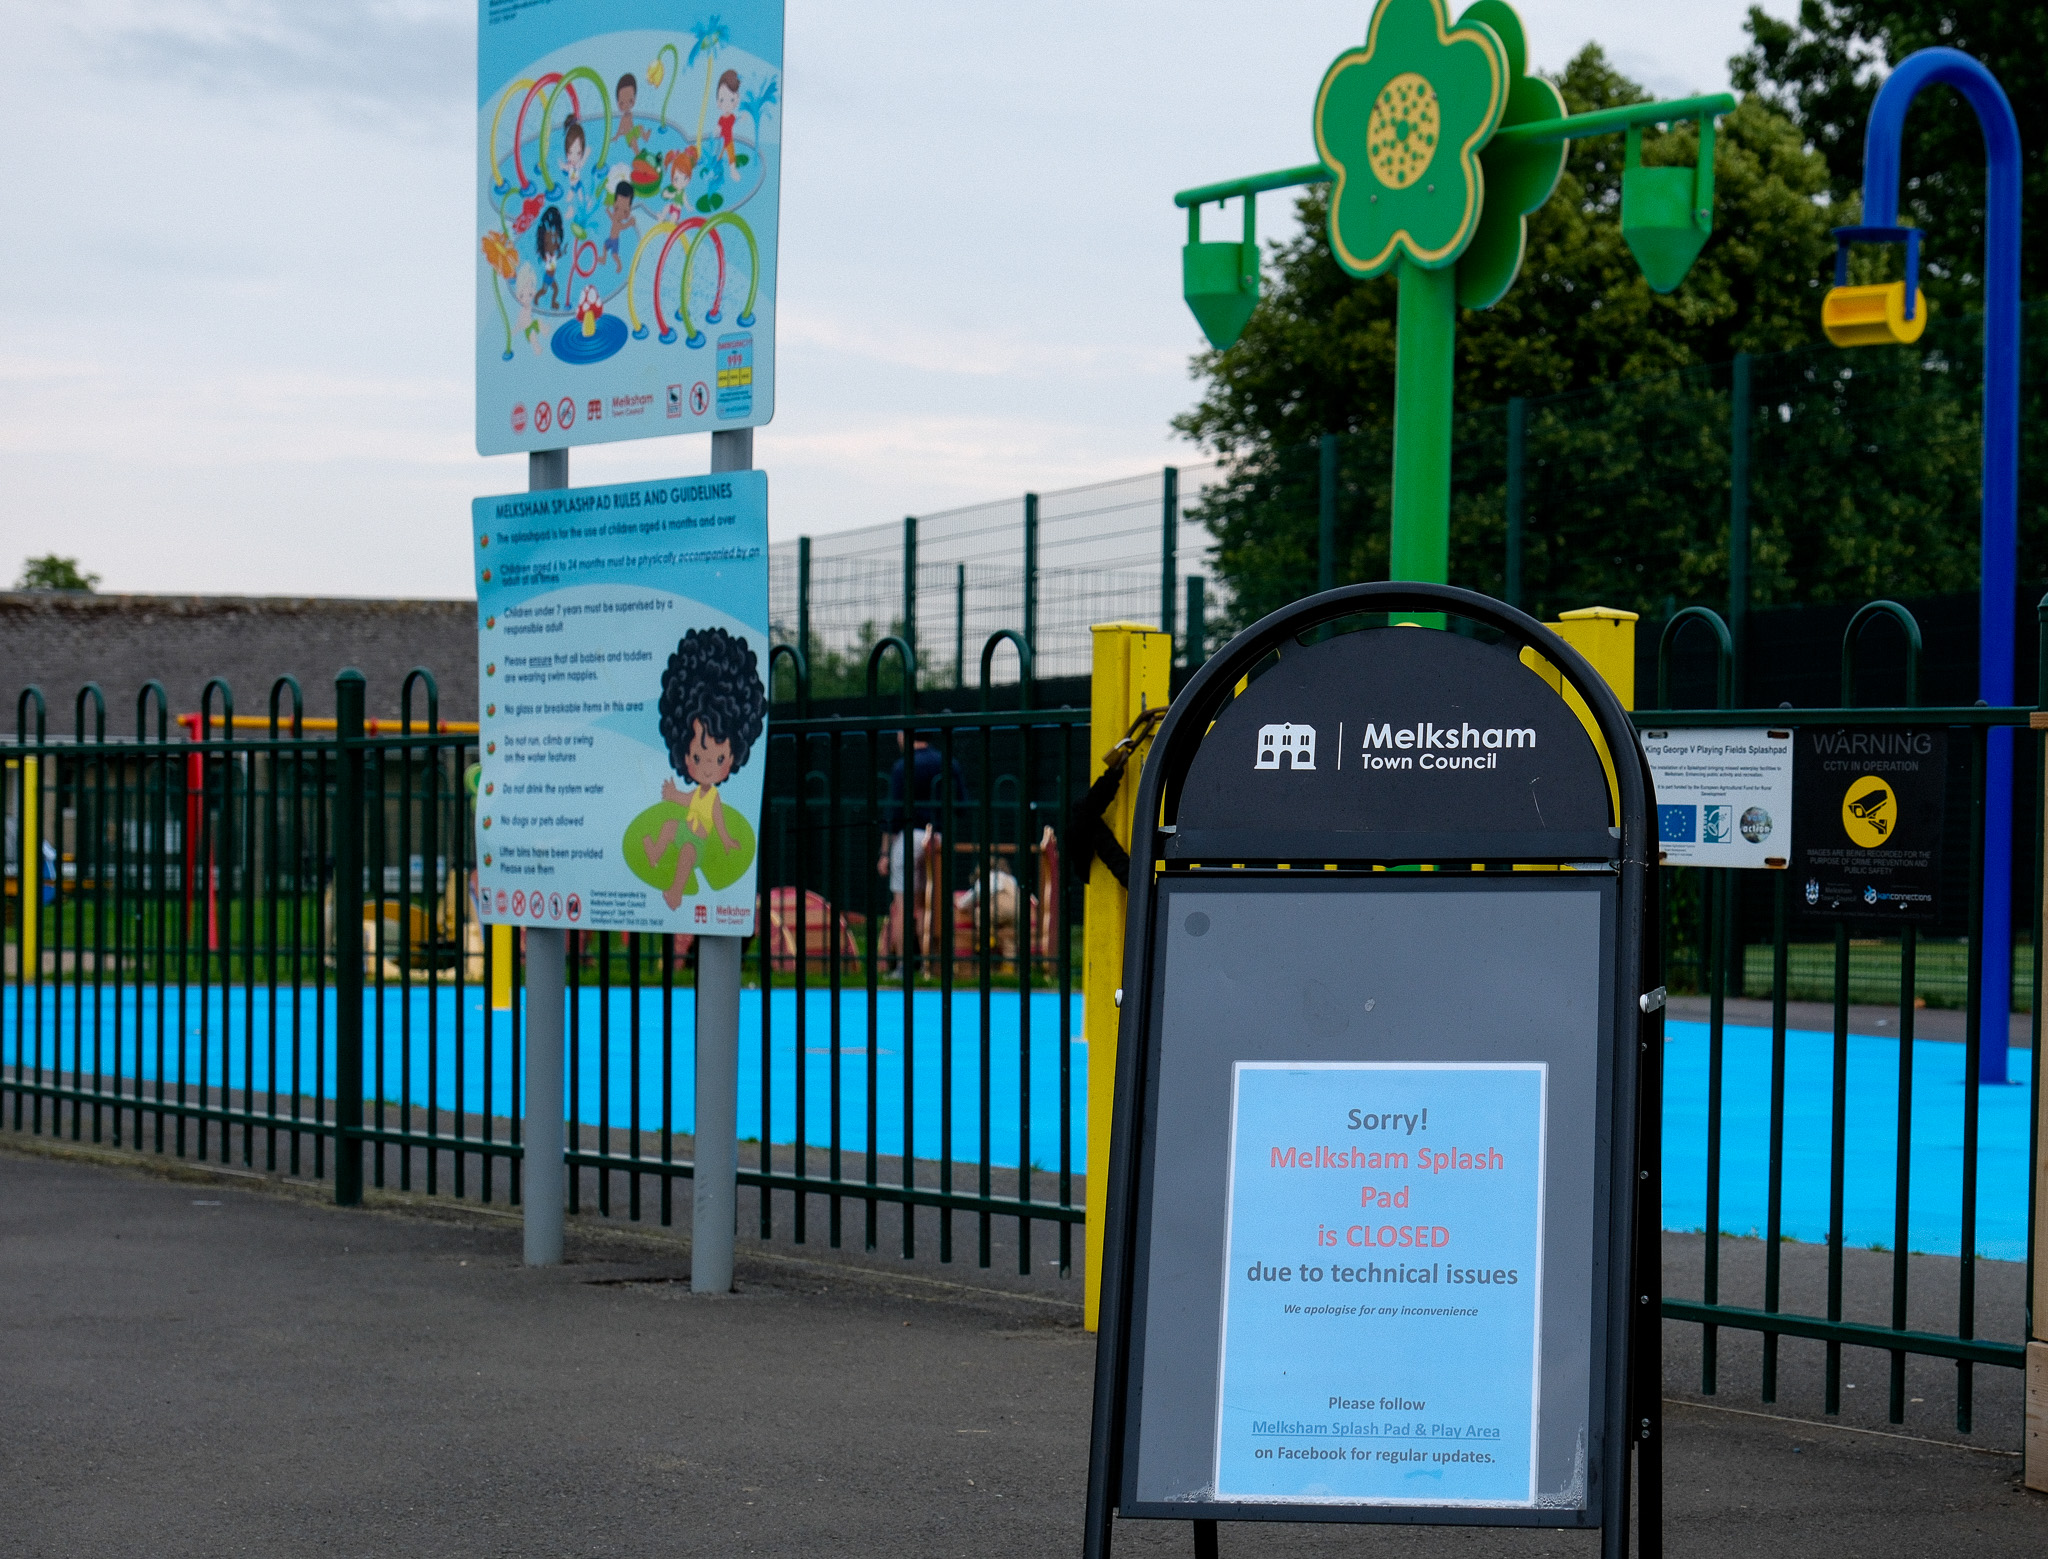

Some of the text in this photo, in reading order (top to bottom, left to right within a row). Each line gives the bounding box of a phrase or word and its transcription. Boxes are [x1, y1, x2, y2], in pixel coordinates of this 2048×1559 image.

[496, 482, 732, 519] MELKSHAM SPLASHPAD RULES AND GUIDELINES
[504, 599, 673, 618] Children under 7 years must be supervised by a
[504, 621, 563, 635] responsible adult
[504, 650, 652, 667] Please ensure that all babies and toddlers
[504, 673, 516, 683] are
[518, 672, 546, 685] wearing
[548, 671, 566, 682] swim
[504, 701, 644, 717] No glass or breakable items in this area
[504, 735, 514, 746] Do
[515, 734, 527, 746] not
[543, 734, 562, 746] climb
[564, 736, 572, 746] or
[573, 733, 594, 748] swing
[1362, 723, 1537, 749] Melksham
[1813, 733, 1931, 754] WARNING
[504, 751, 576, 763] on the water features
[1663, 745, 1688, 756] George
[1690, 745, 1695, 754] V
[1697, 745, 1724, 756] Playing
[1725, 745, 1748, 754] Fields
[1749, 745, 1788, 756] Splashpad
[1362, 753, 1497, 770] Town Council
[1823, 761, 1919, 772] CCTV IN OPERATION
[503, 782, 604, 796] Do not drink the system water
[501, 814, 584, 829] No dogs or pets allowed
[516, 846, 531, 858] bins
[532, 847, 550, 859] have
[550, 848, 570, 859] been
[570, 847, 603, 860] provided
[1807, 849, 1831, 857] IMAGES
[1832, 849, 1845, 857] ARE
[1846, 849, 1866, 858] BEING
[1867, 850, 1903, 858] RECORDED
[1919, 851, 1932, 859] THE
[501, 862, 555, 875] Please use them
[1810, 857, 1929, 868] PURPOSE OF CRIME PREVENTION AND
[1844, 866, 1894, 875] PUBLIC SAFETY
[1347, 1108, 1428, 1136] Sorry!
[1270, 1146, 1504, 1175] Melksham Splash
[1361, 1186, 1410, 1209] Pad
[1318, 1224, 1450, 1248] is CLOSED
[1247, 1261, 1519, 1285] due to technical issues
[1284, 1304, 1479, 1317] We apologise for any inconvenience
[1329, 1397, 1426, 1411] Please follow
[1252, 1421, 1500, 1439] Melksham Splash Pad & Play Area
[1255, 1447, 1496, 1466] on Facebook for regular updates.
